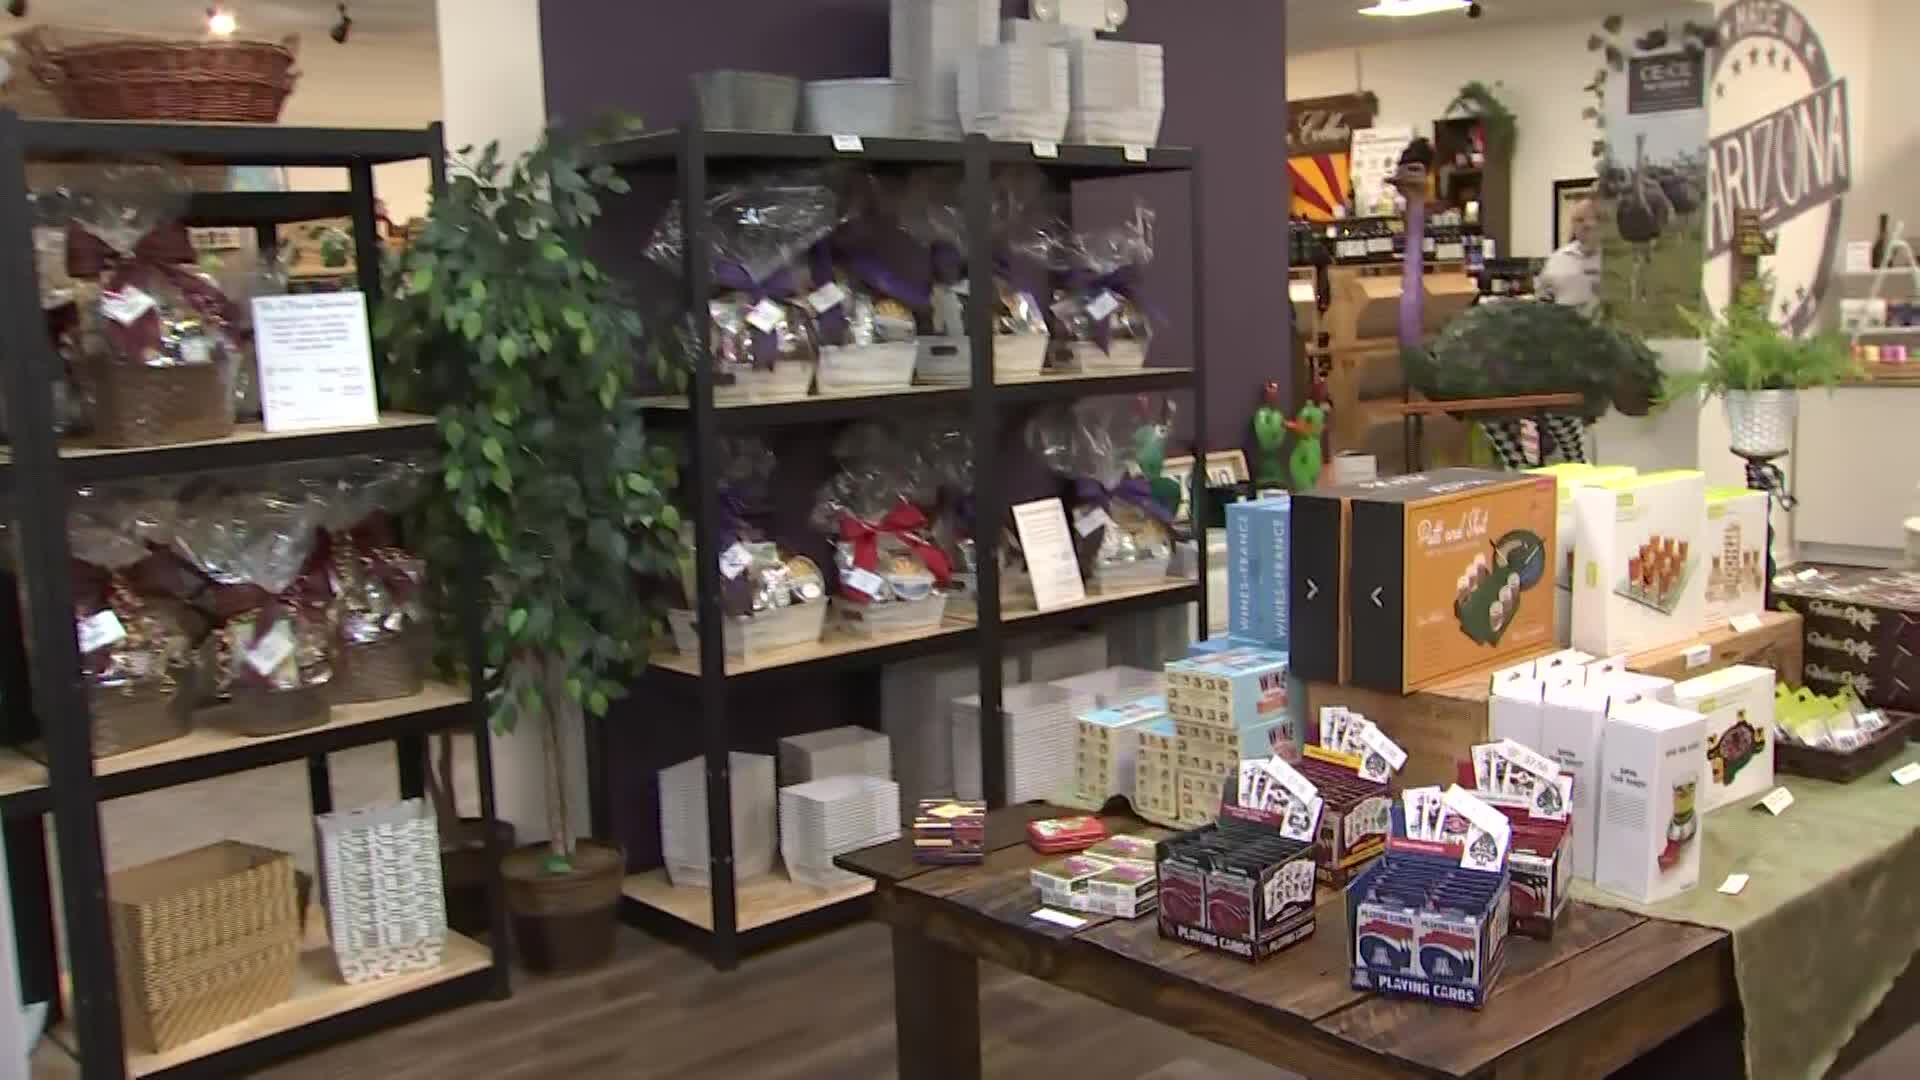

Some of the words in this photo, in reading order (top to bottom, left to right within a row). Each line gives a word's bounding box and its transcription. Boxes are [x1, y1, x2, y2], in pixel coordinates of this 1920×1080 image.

[1706, 82, 1847, 252] ARIZONA
[1378, 975, 1430, 996] PLAYING
[1433, 984, 1475, 1002] CARDS
